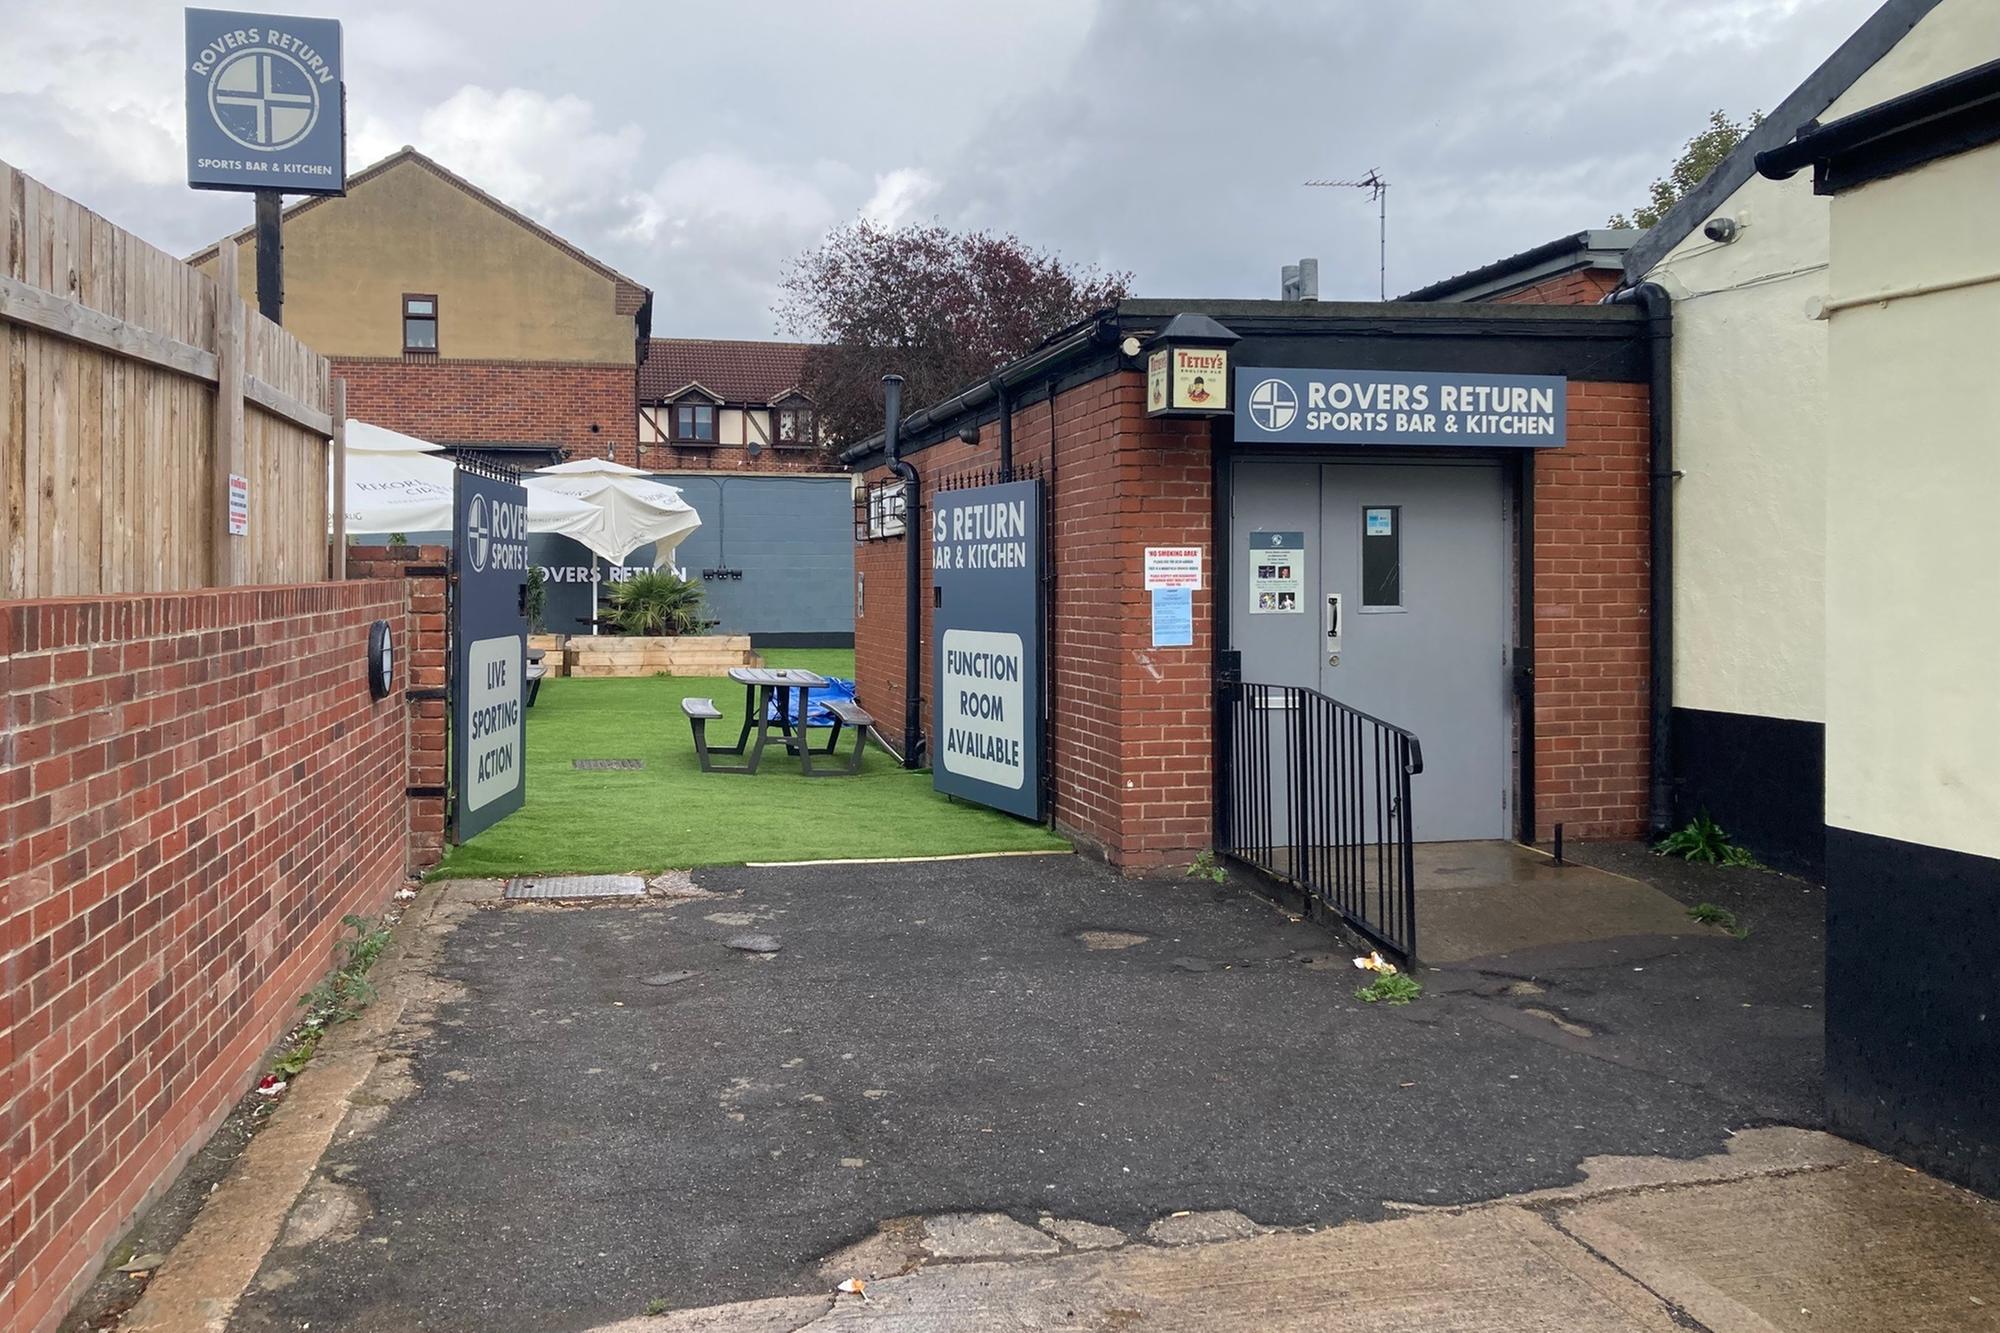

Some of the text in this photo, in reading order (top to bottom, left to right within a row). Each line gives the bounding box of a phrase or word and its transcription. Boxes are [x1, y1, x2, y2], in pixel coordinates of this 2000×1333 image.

[192, 28, 334, 84] ROVERS RETURN
[198, 158, 332, 175] SPORTS BAR & KITCHEN
[1308, 382, 1554, 414] ROVERS RETURN
[1306, 412, 1555, 435] SPORTS BAR & KITCHEN
[953, 500, 1026, 542] RETURN
[492, 543, 522, 570] SPORTS
[933, 542, 1026, 570] AR & KITCHEN
[487, 660, 506, 690] LIVE
[947, 650, 1018, 682] FUNCTION
[472, 699, 518, 740] SPORTING
[960, 690, 1004, 722] ROOM
[947, 727, 1019, 767] AVAILABLE
[477, 743, 512, 784] ACTION
